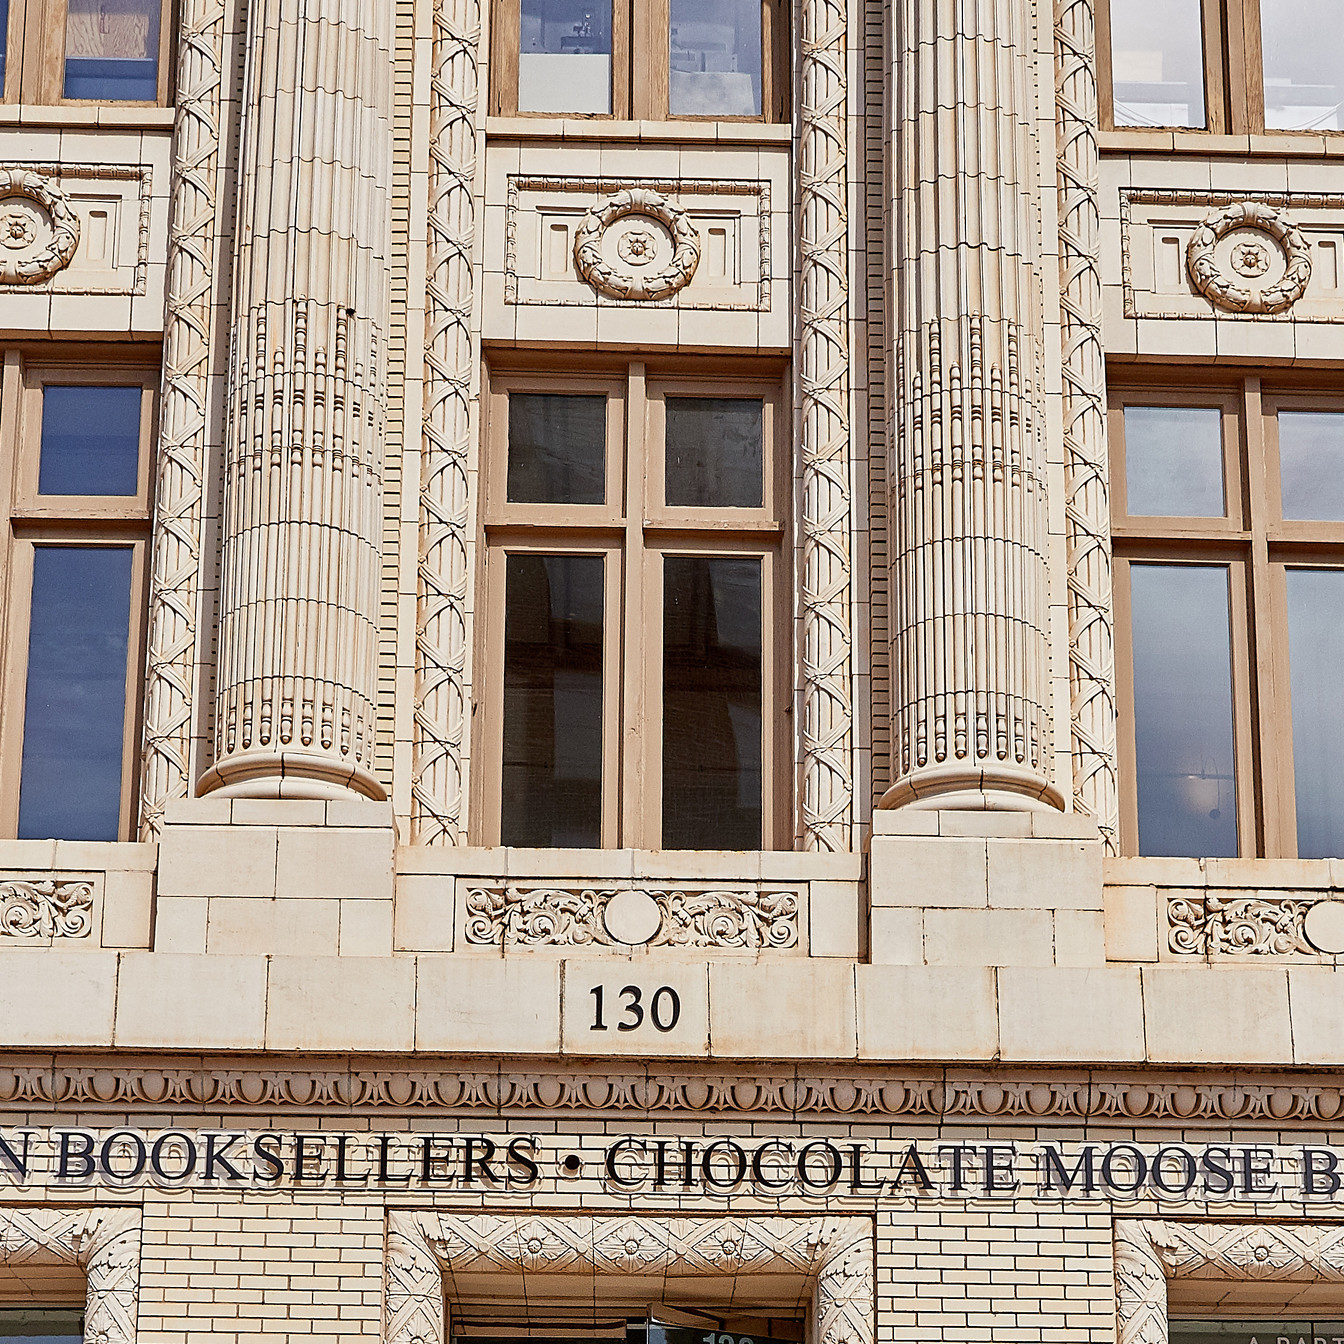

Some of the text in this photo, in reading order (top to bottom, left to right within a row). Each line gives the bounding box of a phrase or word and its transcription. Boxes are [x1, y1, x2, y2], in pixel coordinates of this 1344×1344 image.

[589, 984, 681, 1032] 130
[53, 1131, 540, 1186] BOOKSELLERS
[605, 1139, 1021, 1193] CHOCOLATE
[1040, 1144, 1279, 1194] MOOSE
